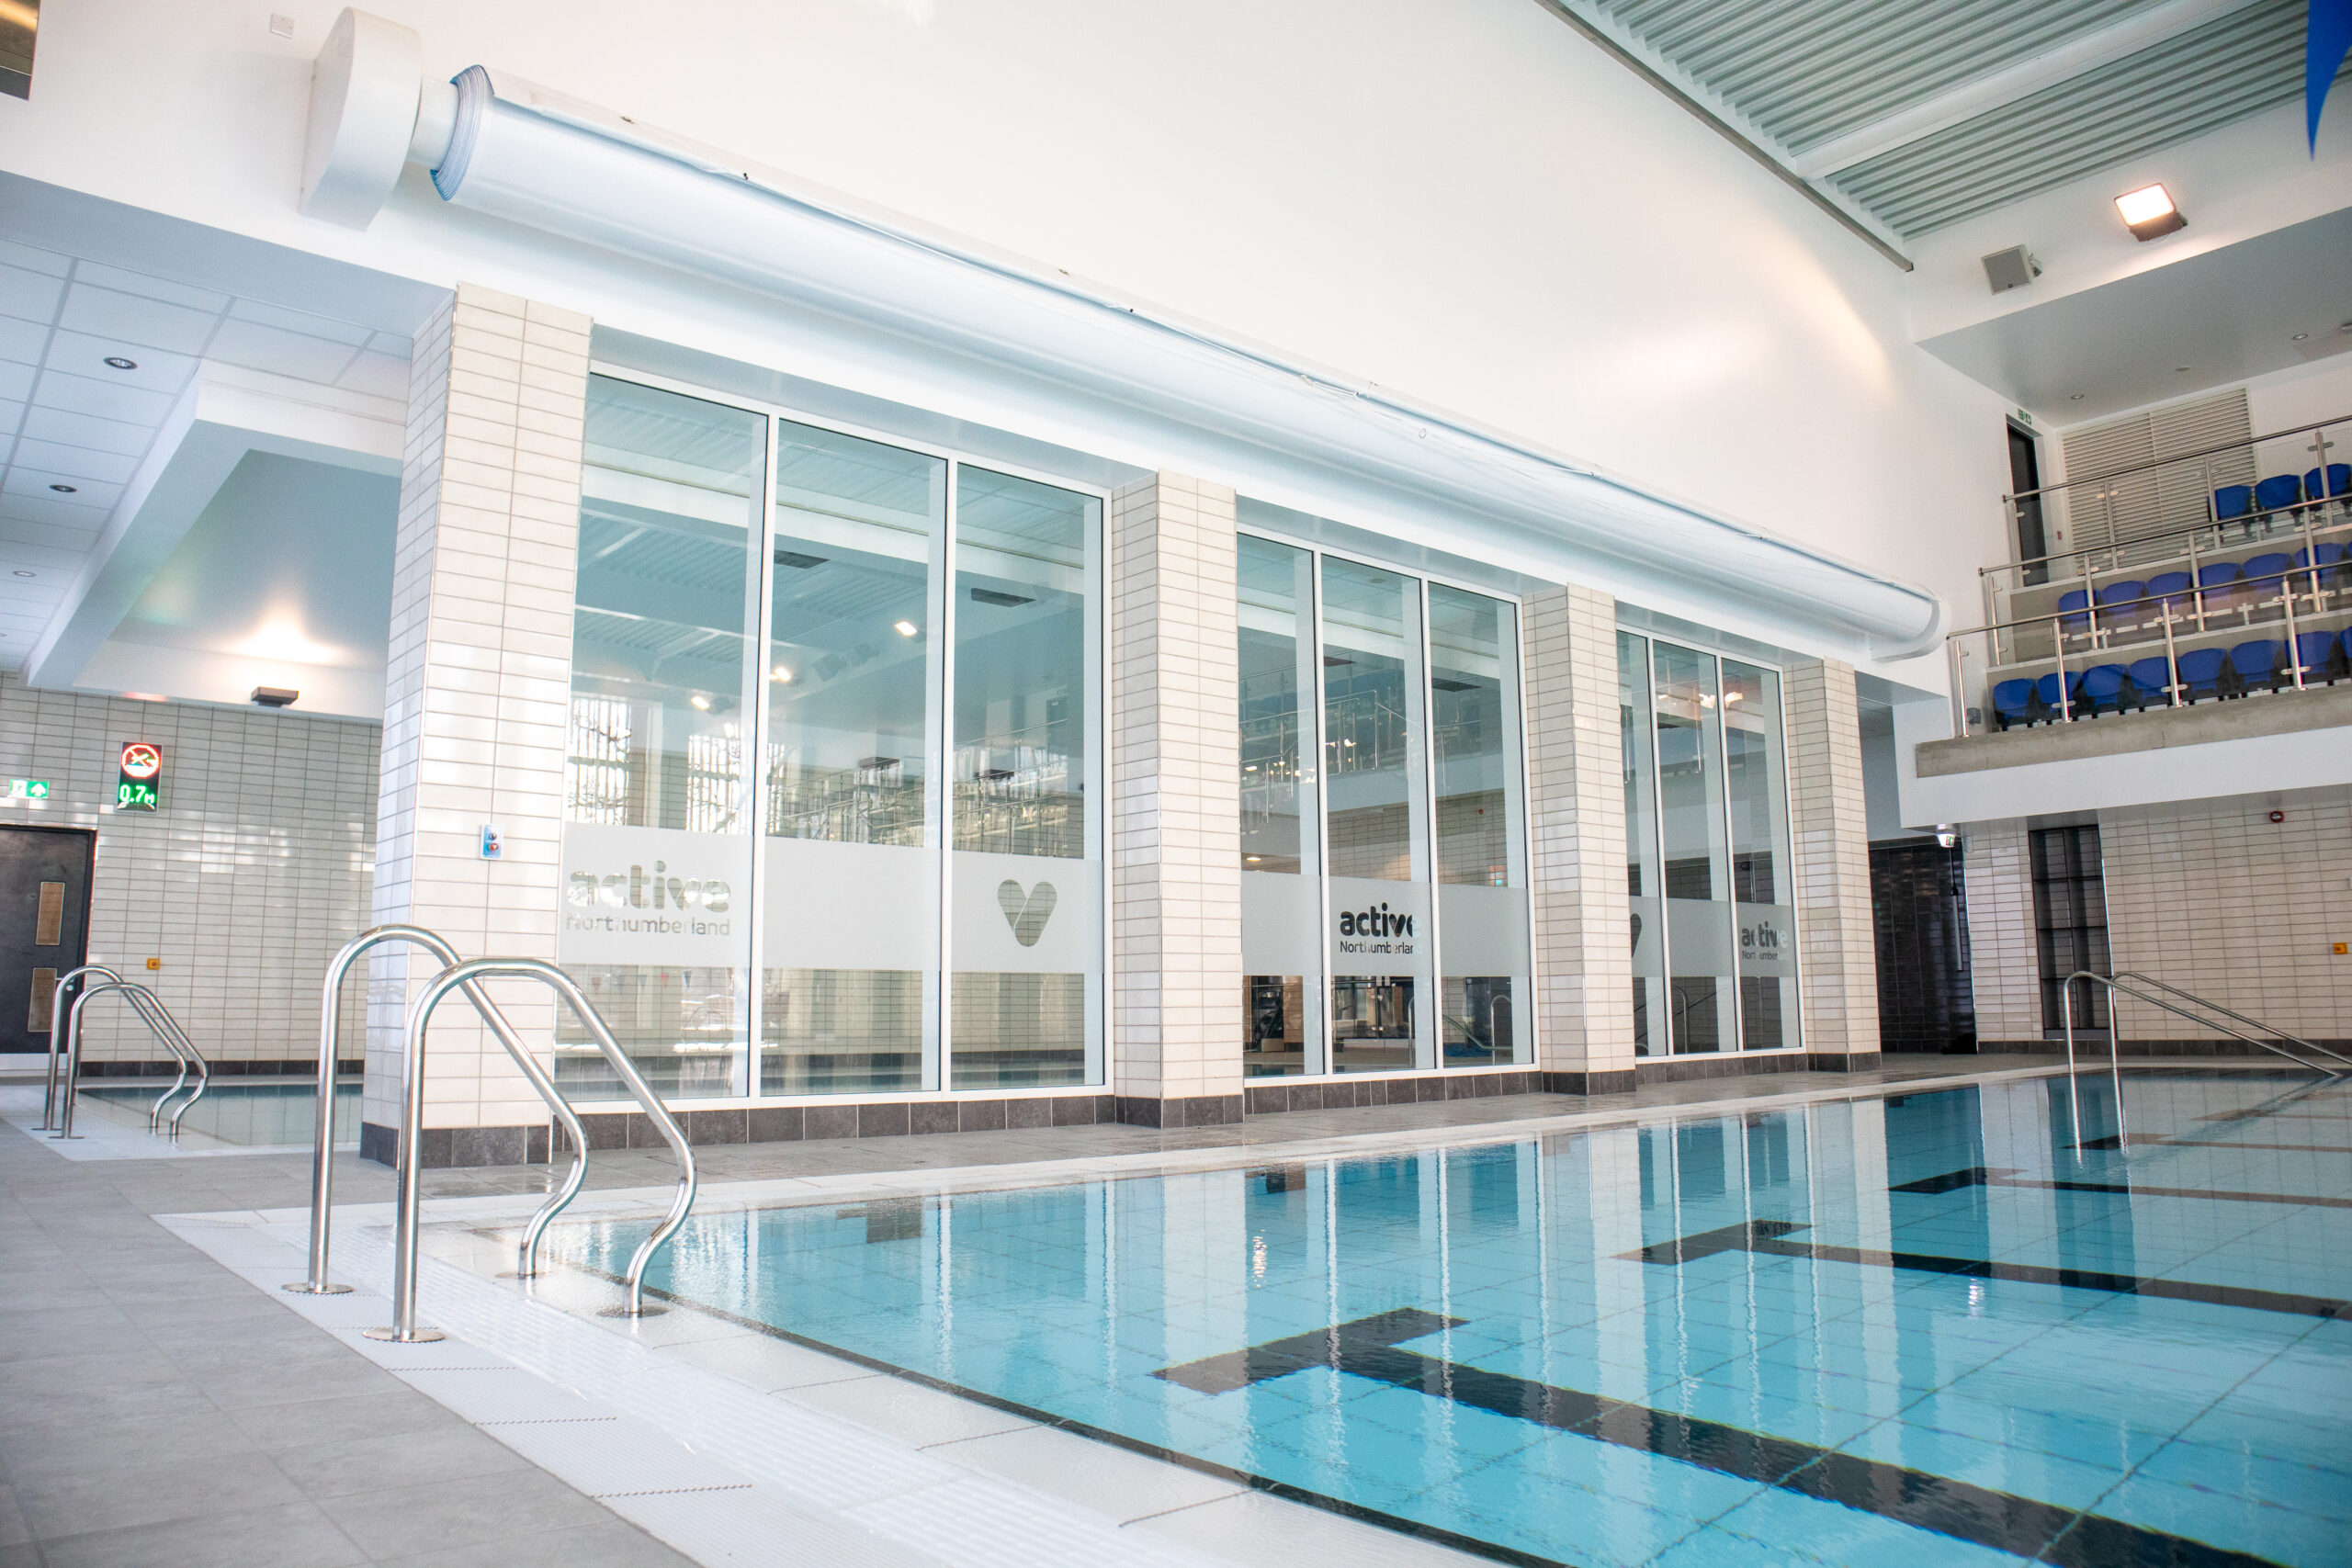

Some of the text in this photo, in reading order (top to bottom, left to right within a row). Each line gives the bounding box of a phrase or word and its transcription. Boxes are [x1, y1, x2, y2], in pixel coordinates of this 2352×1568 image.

[566, 860, 731, 913] active
[566, 912, 730, 936] Northumberland
[1340, 901, 1420, 938] active
[1340, 941, 1421, 954] Northumberla
[1741, 920, 1788, 949] active
